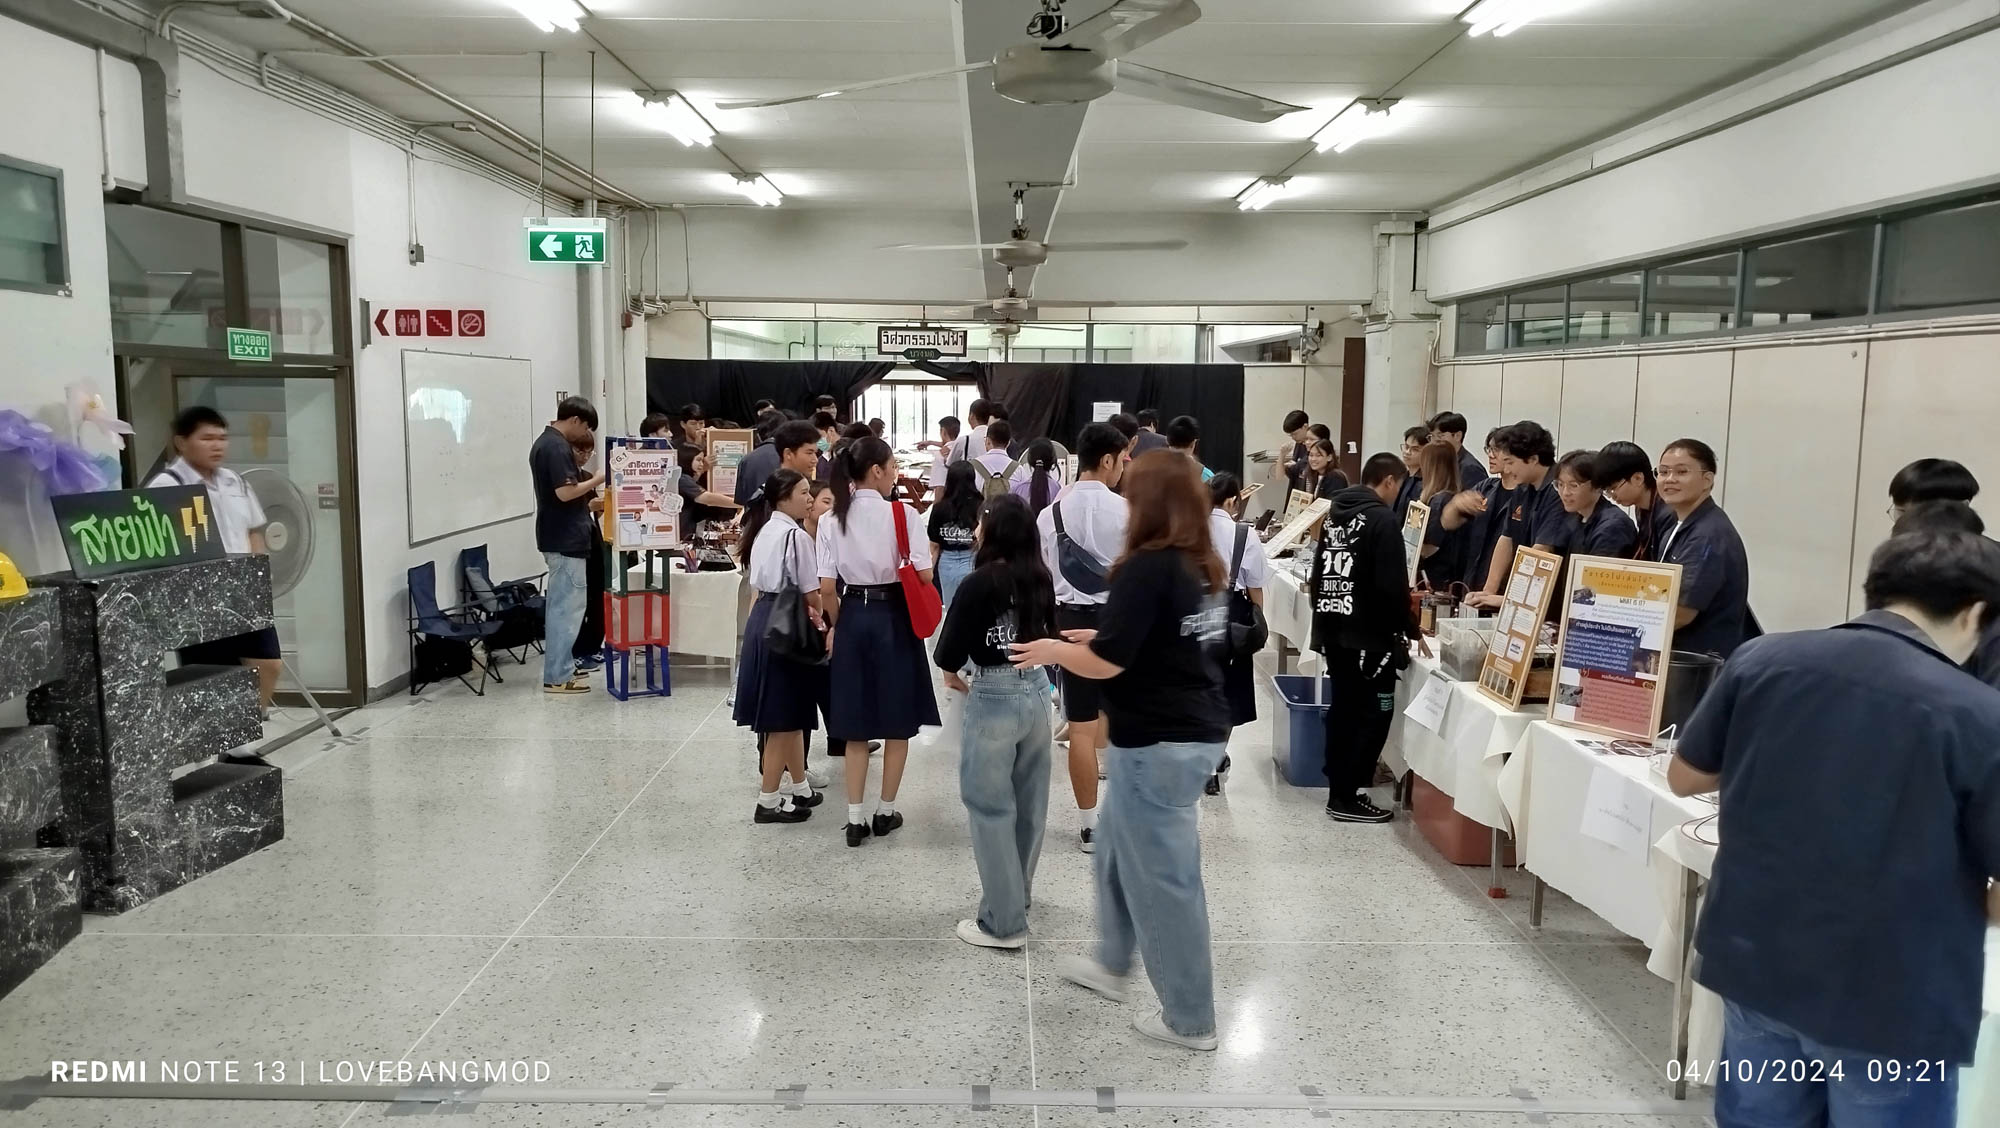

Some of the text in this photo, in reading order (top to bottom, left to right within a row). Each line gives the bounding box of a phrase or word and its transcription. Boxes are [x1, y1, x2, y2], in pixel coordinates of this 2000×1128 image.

[232, 334, 268, 347] ทางออก
[882, 329, 964, 347] วิศวกรรมไฟฟ้า
[234, 345, 268, 356] EXIT
[70, 496, 181, 566] สายฟ้า
[1341, 580, 1355, 591] OF
